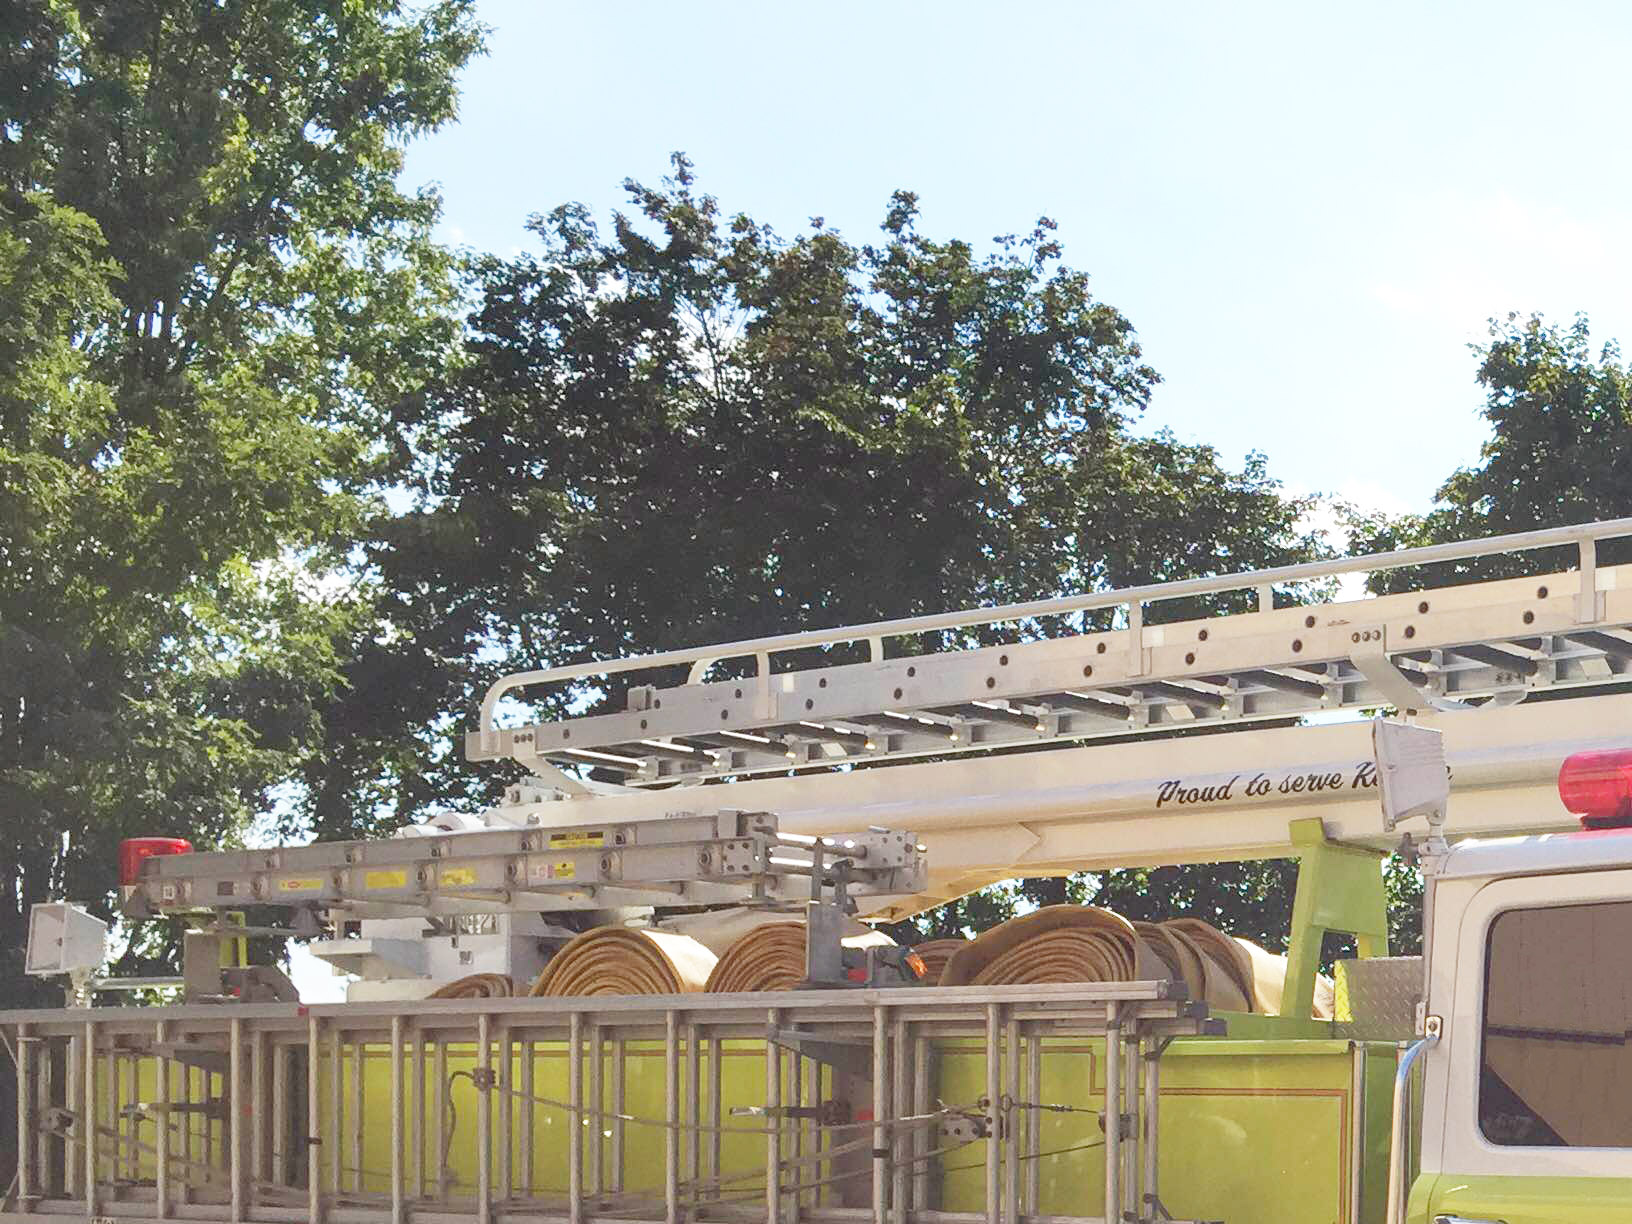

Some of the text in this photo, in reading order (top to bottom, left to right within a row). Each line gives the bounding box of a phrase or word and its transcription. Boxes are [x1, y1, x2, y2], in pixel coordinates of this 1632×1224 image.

[1156, 775, 1240, 808] Proud
[1245, 772, 1272, 797] to
[1277, 771, 1343, 793] serve
